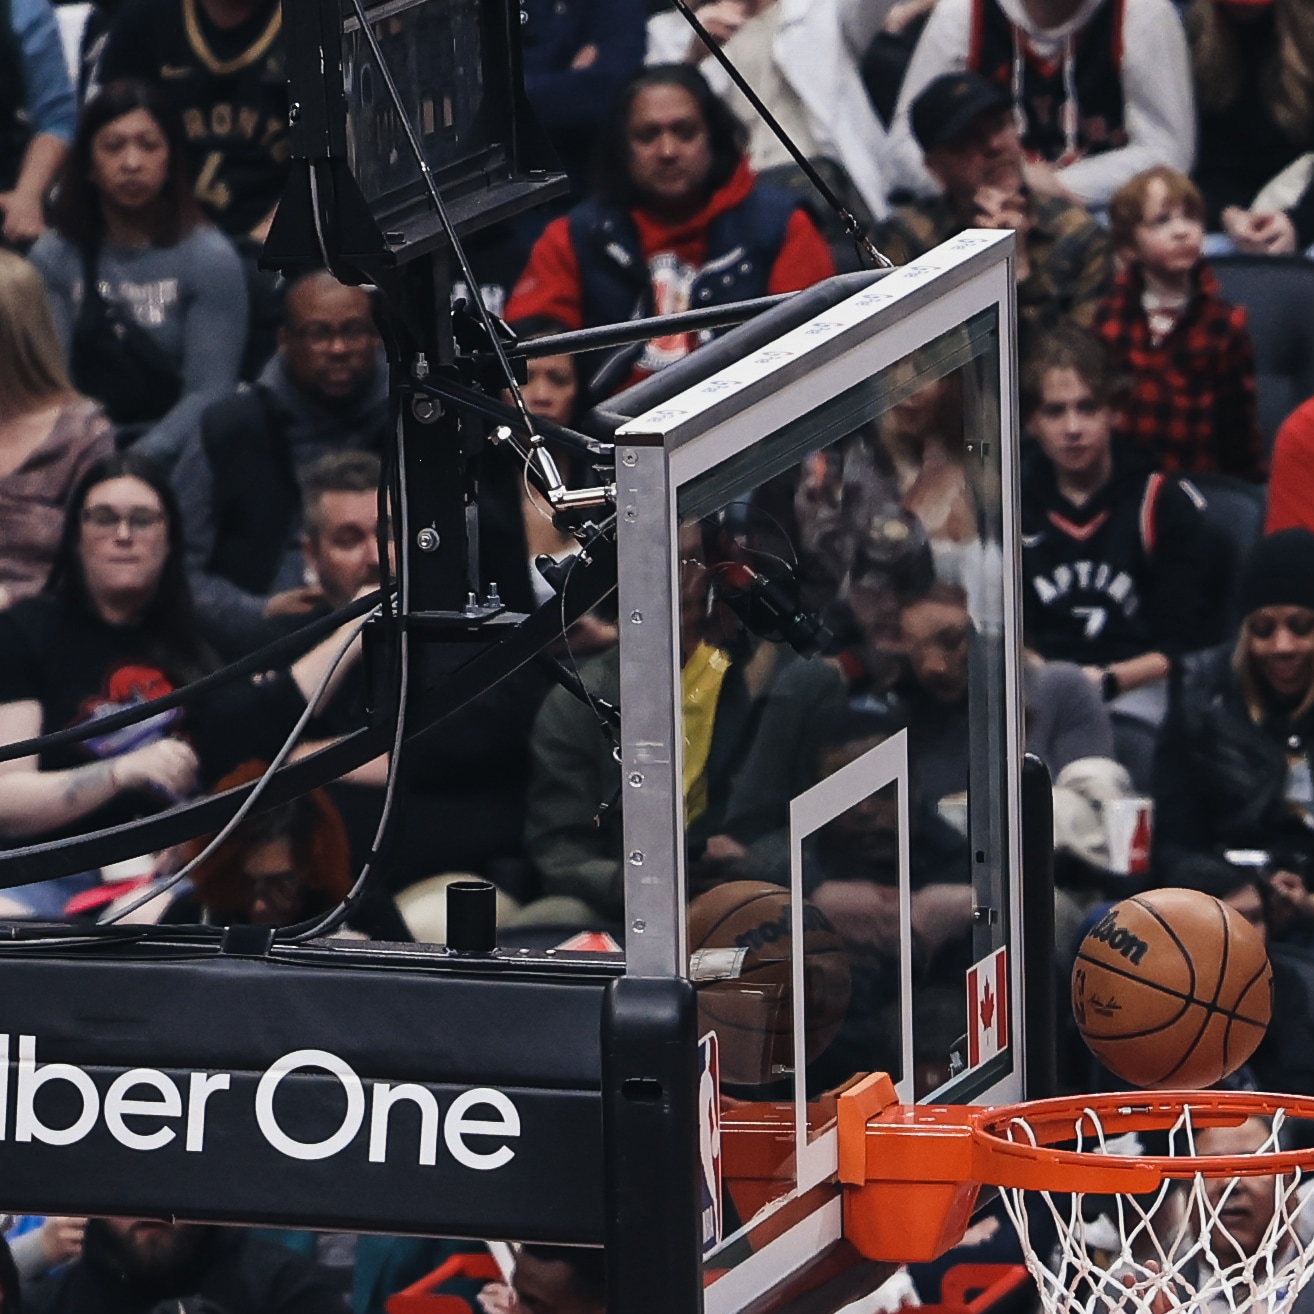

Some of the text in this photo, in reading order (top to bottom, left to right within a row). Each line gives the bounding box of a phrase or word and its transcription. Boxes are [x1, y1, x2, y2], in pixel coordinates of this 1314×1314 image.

[1090, 910, 1149, 967] lson
[0, 1034, 521, 1171] ber One
